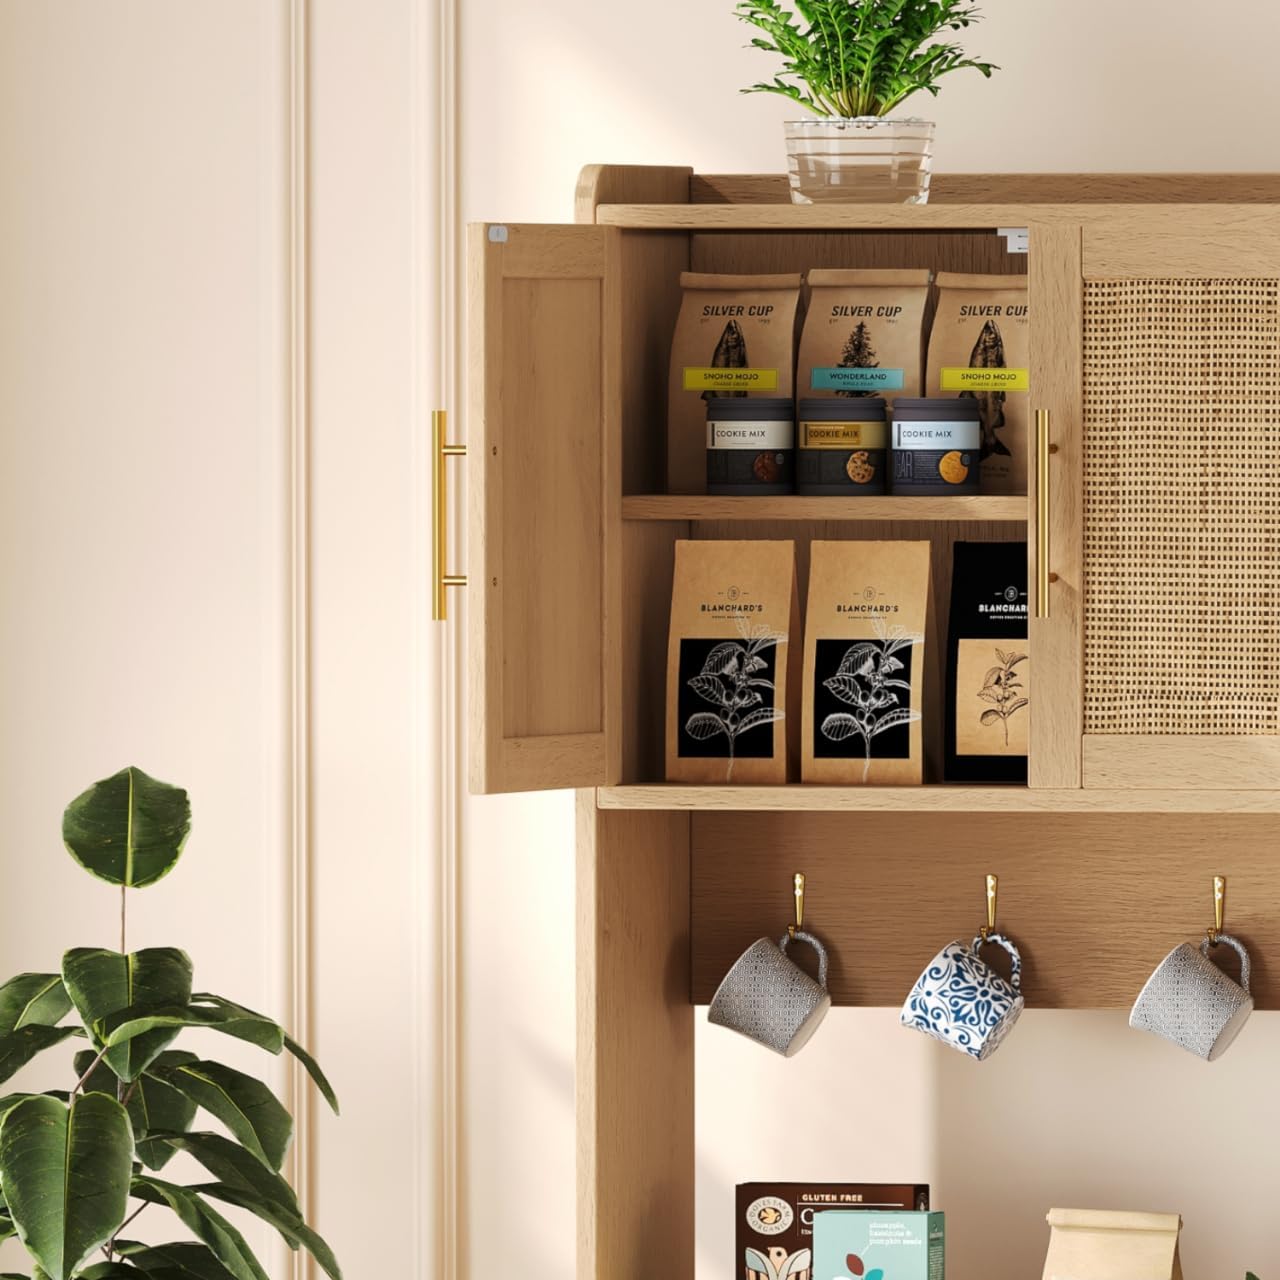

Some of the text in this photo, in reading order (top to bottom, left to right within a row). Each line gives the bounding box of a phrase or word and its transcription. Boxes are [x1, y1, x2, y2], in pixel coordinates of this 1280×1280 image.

[703, 305, 774, 317] SILVER CUP
[831, 305, 902, 318] SILVER CUP
[960, 305, 1002, 317] SILVER
[704, 373, 759, 381] SNOHO MOJO
[961, 373, 1017, 381] SNOHO MOJO
[716, 430, 766, 438] COOKIE MIX
[809, 430, 859, 438] COOKIE MIX
[903, 430, 952, 438] COOKIE MIX
[701, 604, 763, 612] BLANCHARD'S
[836, 604, 899, 613] BLANCHARD'S
[978, 604, 1028, 613] BLANCHAR
[802, 1194, 863, 1202] GLUTEN FREE
